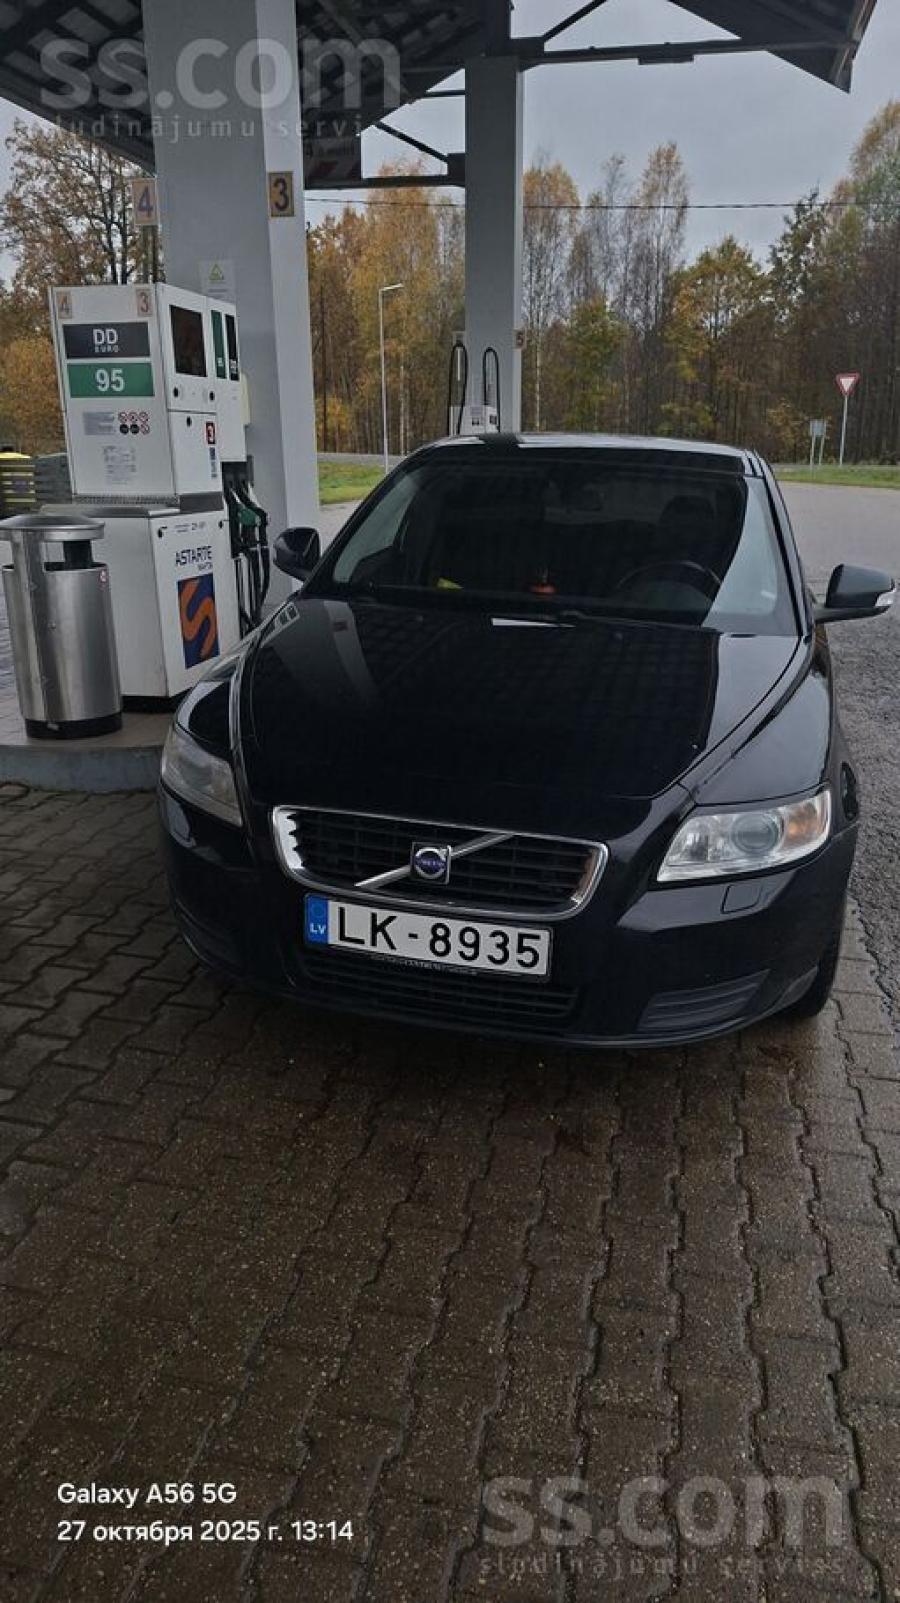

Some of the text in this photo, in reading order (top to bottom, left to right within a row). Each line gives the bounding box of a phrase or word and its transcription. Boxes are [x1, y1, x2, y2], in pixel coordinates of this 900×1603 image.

[138, 187, 154, 217] 4
[273, 178, 289, 210] 3
[142, 292, 150, 313] 3
[93, 328, 119, 345] DD
[95, 368, 126, 392] 95
[176, 546, 213, 565] ASTARTE
[310, 923, 326, 935] LV
[337, 906, 542, 968] LK-8935
